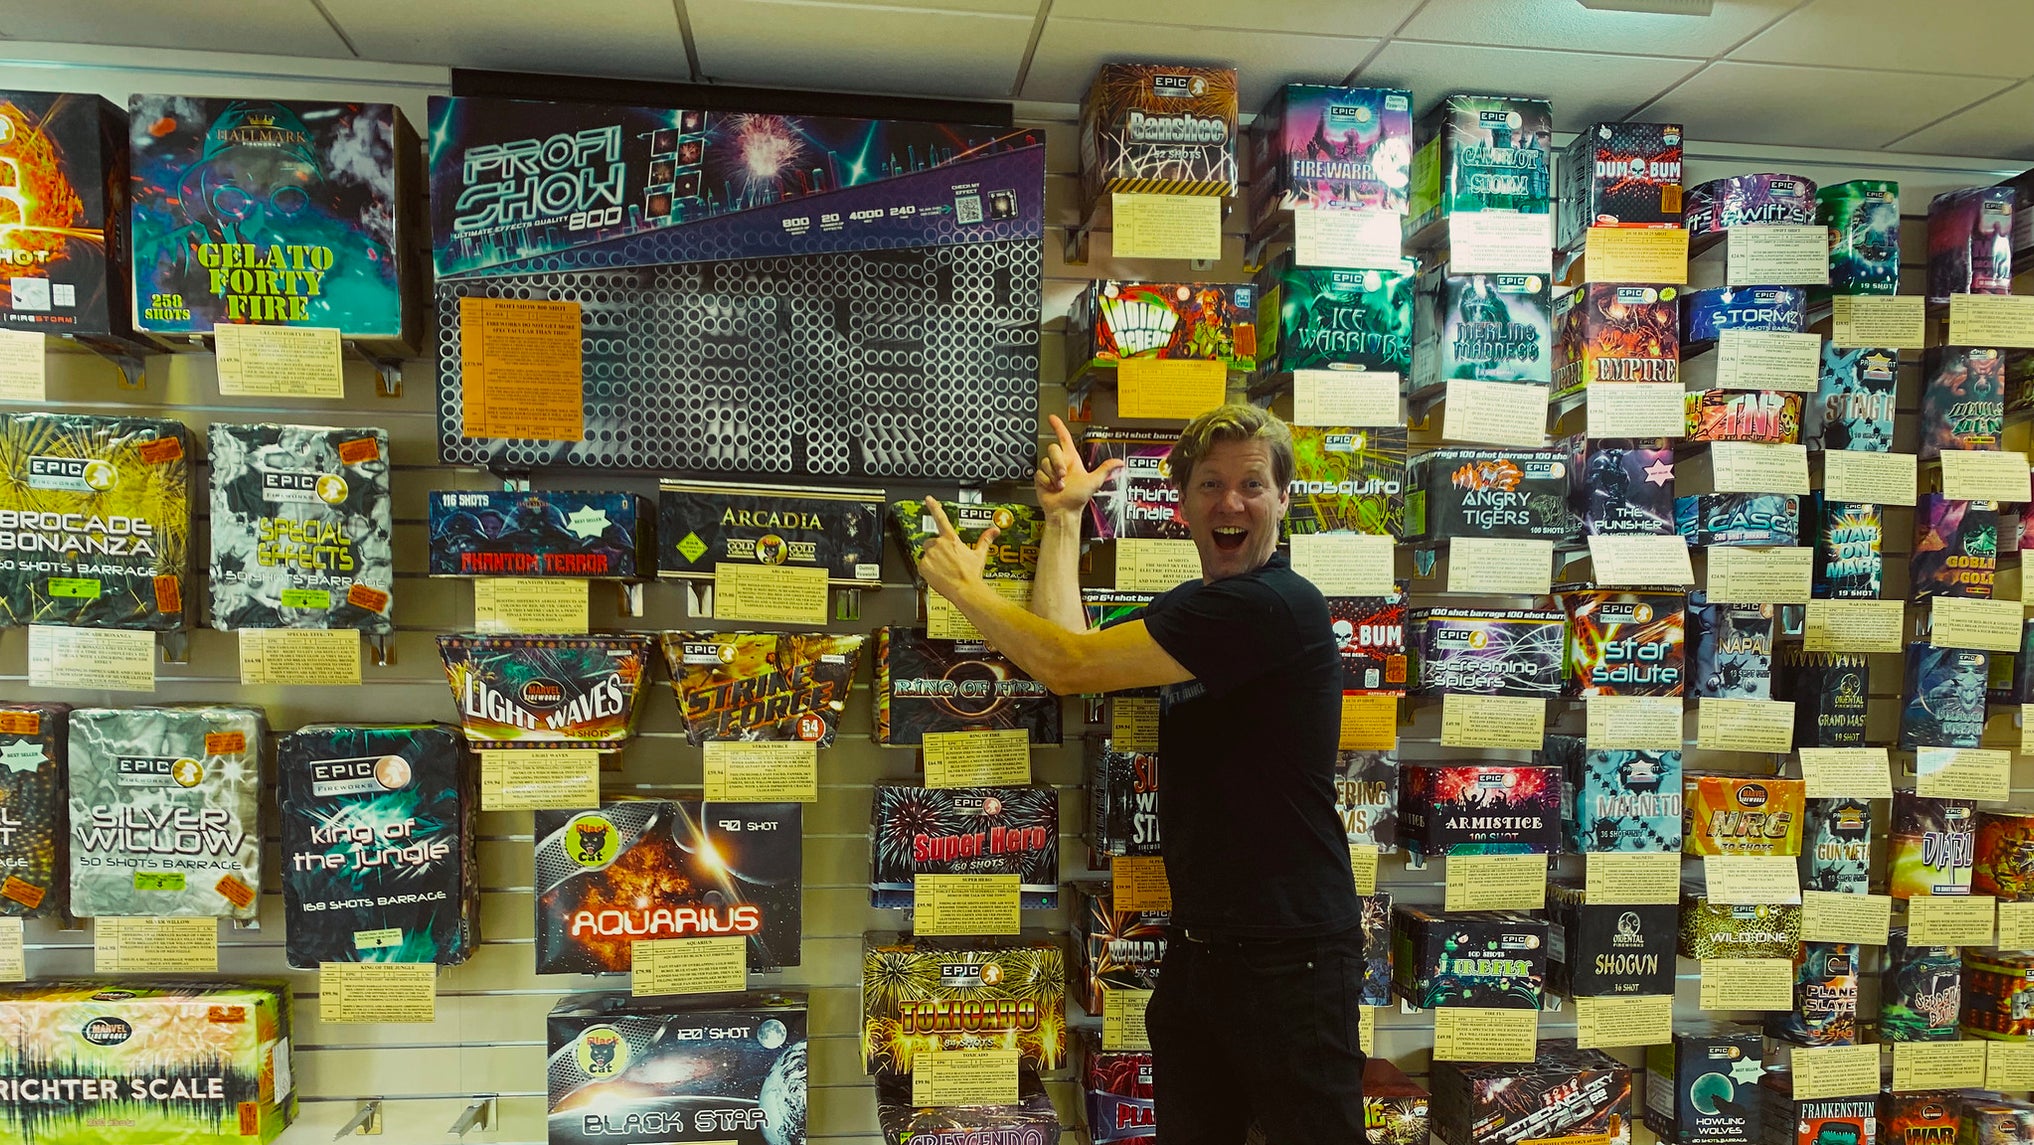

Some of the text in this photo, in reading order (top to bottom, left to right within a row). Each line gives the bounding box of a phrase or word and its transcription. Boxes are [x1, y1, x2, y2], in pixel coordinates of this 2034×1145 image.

[1155, 78, 1187, 87] EPIC
[1332, 107, 1355, 115] EPIC
[1481, 113, 1505, 121] EPIC
[1130, 112, 1225, 142] Banshee
[216, 128, 306, 144] HALLMARK
[463, 124, 622, 186] PROFI
[1461, 146, 1539, 170] CAMELOT
[1293, 160, 1323, 178] FIRE
[1596, 161, 1627, 178] DUM
[1650, 161, 1681, 178] BUM
[1470, 174, 1529, 195] STORM
[453, 162, 627, 232] SHOW
[821, 213, 840, 224] 20
[849, 208, 884, 221] 4000
[890, 205, 916, 216] 240
[453, 206, 622, 239] ULTIMATE QUALITY 800
[782, 217, 810, 228] 800
[197, 243, 334, 270] GELATO
[209, 269, 326, 296] FORTY
[1333, 275, 1363, 283] EPIC
[151, 293, 182, 308] 258
[227, 295, 310, 321] FIRE
[9, 313, 73, 324] FIRESTORM
[144, 308, 191, 321] SHOTS
[1333, 307, 1367, 331] ICE
[1712, 309, 1805, 326] STORMZY
[1456, 322, 1537, 342] MERLINS
[1113, 329, 1173, 358] SCREAM
[1298, 328, 1398, 365] WARRIOR
[1453, 340, 1540, 363] MADNESS
[1597, 357, 1676, 382] EMPIRE
[1726, 392, 1785, 437] TNT
[1825, 392, 1881, 422] STING
[1130, 431, 1152, 439] shot
[1326, 436, 1351, 444] EPIC
[1129, 459, 1158, 468] EPIC
[1476, 451, 1497, 459] shot
[32, 461, 83, 476] EPIC
[266, 474, 314, 489] EPIC
[1287, 478, 1400, 496] mosquito
[442, 494, 489, 507] 116 SHOTS
[1462, 491, 1531, 511] ANGRY
[719, 506, 824, 531] ARCADIA
[960, 509, 992, 519] EPIC
[1126, 505, 1175, 521] finale
[1463, 510, 1530, 530] TIGERS
[1616, 507, 1643, 518] THE
[0, 509, 152, 536] BROCADE
[259, 516, 352, 546] SPECIAL
[1594, 520, 1663, 530] PUNISHER
[0, 530, 156, 557] BONANZA
[1831, 526, 1880, 544] WAR
[727, 542, 755, 551] GOLD
[788, 544, 816, 553] GOLD
[1840, 543, 1871, 560] ON
[257, 546, 355, 572] EFFECTS
[461, 552, 608, 574] PHANTOM TERROR
[1826, 556, 1881, 578] MARS
[19, 560, 158, 578] SHOTS BARRAGE
[1431, 608, 1447, 616] 100
[1449, 609, 1469, 617] shot
[1470, 610, 1506, 618] barrage
[1523, 611, 1545, 619] shot
[1602, 604, 1632, 614] EPIC
[1360, 624, 1402, 646] BUM
[685, 645, 717, 654] EPIC
[1435, 659, 1539, 676] screaming
[687, 661, 816, 716] STRIKE
[894, 677, 1048, 699] RING OF FIRE
[1434, 673, 1506, 689] spiders
[528, 685, 560, 695] MARVEL
[465, 671, 624, 731] LIGHT WAVES
[718, 680, 834, 736] FORCE
[578, 729, 610, 738] SHOTS
[802, 719, 818, 732] 54
[120, 760, 170, 773] EPIC
[315, 763, 372, 779] EPIC
[954, 799, 983, 807] EPIC
[1597, 793, 1682, 819] MAGNETO
[92, 805, 230, 831] SILVER
[747, 821, 778, 831] SHOT
[1446, 816, 1544, 831] ARMISTICE
[1705, 810, 1793, 839] NRG
[384, 817, 415, 839] of
[77, 826, 247, 856] WILLOW
[913, 825, 1047, 863] Super Hero
[293, 842, 450, 872] the jungle
[1817, 844, 1843, 861] GUN
[80, 857, 242, 870] 50 SHOTS BARRAGE
[970, 859, 1005, 870] SHOTS
[303, 891, 447, 912] 168 SHOTS BARRAGE
[571, 905, 760, 937] AQUARIUS
[1502, 935, 1525, 943] EPIC
[1709, 931, 1789, 943] WILD ONE
[943, 966, 979, 976] EPIC
[1437, 958, 1534, 977] FIREFLY
[1594, 953, 1659, 976] SHOGUN
[1806, 984, 1858, 998] PLANE
[1805, 999, 1857, 1012] SLAYE
[900, 998, 1039, 1034] TOXICADO
[92, 1023, 127, 1034] MARVEL
[709, 1027, 750, 1040] SHOT
[0, 1077, 224, 1101] RICHTER SCALE
[1801, 1101, 1875, 1119] FRANKENSTEIN
[582, 1108, 770, 1136] BLACK STAR
[1695, 1117, 1746, 1127] HOWLING
[1698, 1126, 1743, 1135] WOLVES
